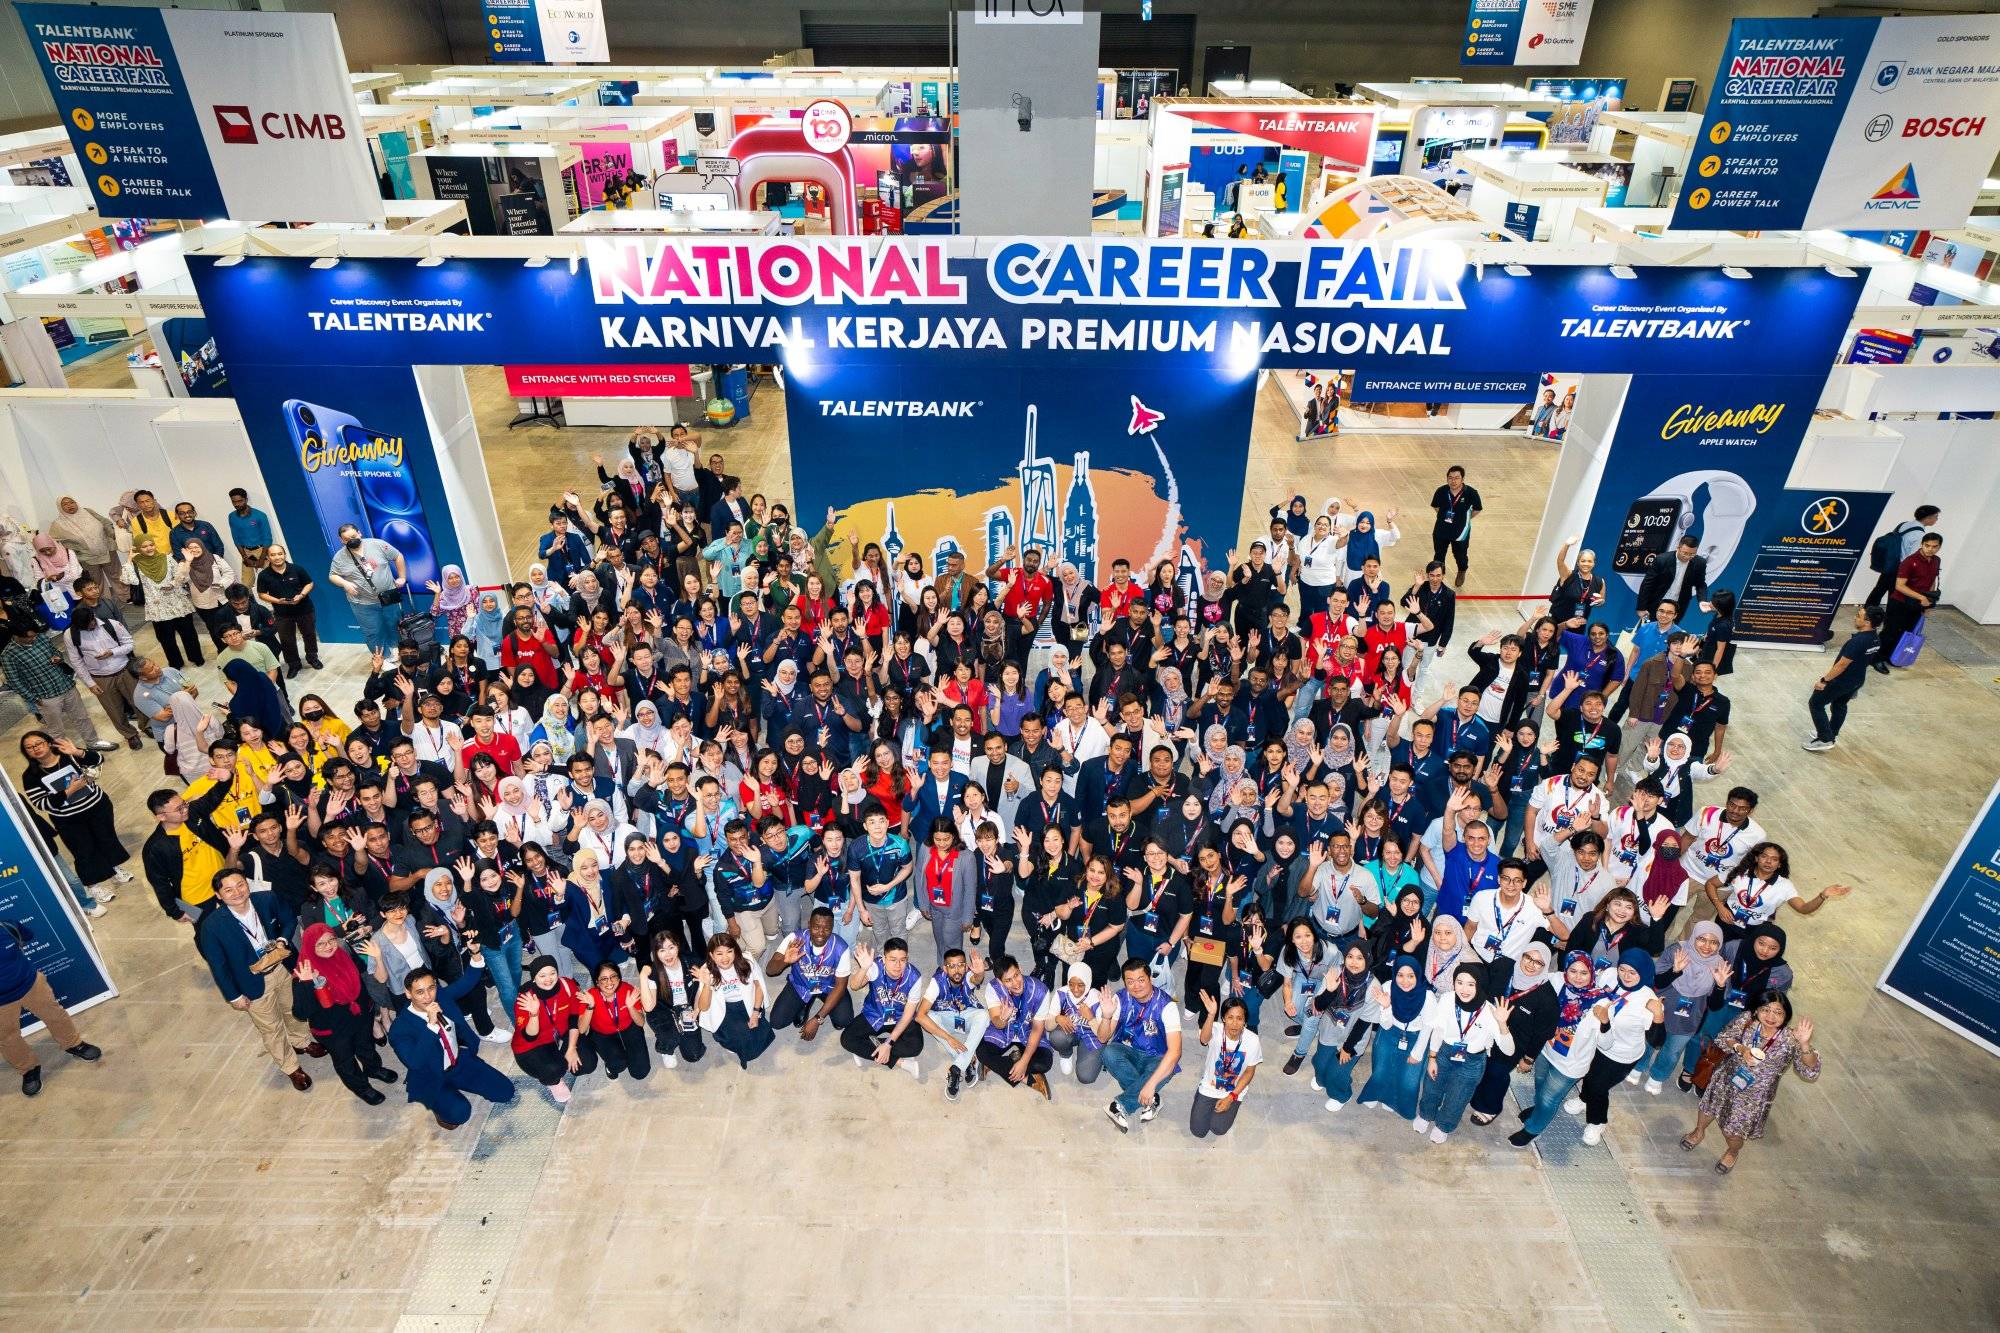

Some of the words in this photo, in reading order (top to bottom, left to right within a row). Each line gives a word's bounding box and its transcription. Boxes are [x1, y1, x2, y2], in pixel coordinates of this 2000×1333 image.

[1558, 2, 1578, 10] SME
[43, 42, 163, 67] NATIONAL
[1729, 56, 1845, 78] NATIONAL
[1907, 66, 1934, 75] BANK
[1936, 66, 1974, 75] NEGARA
[55, 65, 128, 84] CAREER
[126, 68, 170, 86] FAIR
[1725, 78, 1795, 96] CAREER
[1795, 78, 1838, 96] FAIR
[97, 112, 128, 122] MORE
[100, 122, 165, 131] EMPLOYERS
[261, 112, 346, 140] CIMB
[1258, 119, 1360, 133] TALENTBANK
[1736, 124, 1770, 134] MORE
[1901, 117, 1987, 138] BOSCH
[864, 133, 898, 141] micron
[1732, 133, 1798, 142] EMPLOYERS
[109, 146, 145, 155] SPEAK
[147, 147, 162, 156] TO
[1214, 145, 1244, 155] UOB
[113, 154, 121, 162] A
[124, 154, 168, 164] MENTOR
[1725, 158, 1762, 167] SPEAK
[1765, 158, 1779, 166] TO
[435, 169, 458, 177] Where
[1722, 168, 1730, 176] A
[1732, 168, 1779, 176] MENTOR
[437, 177, 452, 185] your
[590, 172, 611, 183] WITH
[121, 178, 164, 188] CAREER
[439, 184, 468, 192] potential
[125, 187, 163, 197] POWER
[166, 188, 192, 197] TALK
[441, 191, 470, 199] becomes
[1716, 191, 1758, 200] CAREER
[1712, 199, 1752, 208] POWER
[1754, 199, 1780, 208] TALK
[1864, 200, 1921, 210] MCMC
[506, 208, 527, 216] Where
[508, 215, 523, 224] your
[510, 221, 537, 230] potential
[511, 228, 538, 236] becomes
[1889, 235, 1905, 246] TM
[590, 238, 967, 304] NATIONAL
[987, 238, 1280, 305] CAREER
[1298, 241, 1466, 308] FAIR
[413, 299, 451, 307] Organised
[452, 299, 462, 307] By
[1677, 306, 1715, 314] Organised
[1716, 306, 1727, 314] By
[601, 316, 815, 348] KARNIVAL
[827, 317, 1007, 349] KERJAYA
[1021, 318, 1217, 351] PREMIUM
[1230, 322, 1452, 355] NASIONAL
[522, 375, 577, 384] ENTRANCE
[579, 376, 607, 384] WITH
[610, 375, 631, 384] RED
[633, 374, 676, 384] STICKER
[1366, 381, 1422, 390] ENTRANCE
[1424, 382, 1452, 390] WITH
[1454, 382, 1482, 390] BLUE
[1483, 382, 1527, 392] STICKER
[1660, 403, 1786, 440] Giveaway
[1700, 438, 1725, 446] APPLE
[1726, 438, 1757, 446] WATCH
[301, 437, 403, 473] Giveaway
[340, 470, 362, 478] APPLE
[363, 470, 393, 478] IPHONE
[1644, 516, 1670, 526] 10:09
[1797, 537, 1847, 545] SOLICITING
[1398, 816, 1408, 824] We
[11, 894, 18, 902] in
[1975, 892, 1991, 902] Scan
[1978, 901, 1996, 914] using
[1960, 912, 1972, 923] You
[1973, 918, 1985, 928] will
[1967, 924, 1986, 938] email
[31, 941, 39, 949] to
[36, 942, 50, 951] and
[1942, 938, 1965, 953] collect
[1964, 949, 1980, 962] your
[1952, 937, 1981, 956] Proceed
[1960, 954, 1977, 967] lucky
[1978, 963, 1996, 976] draw
